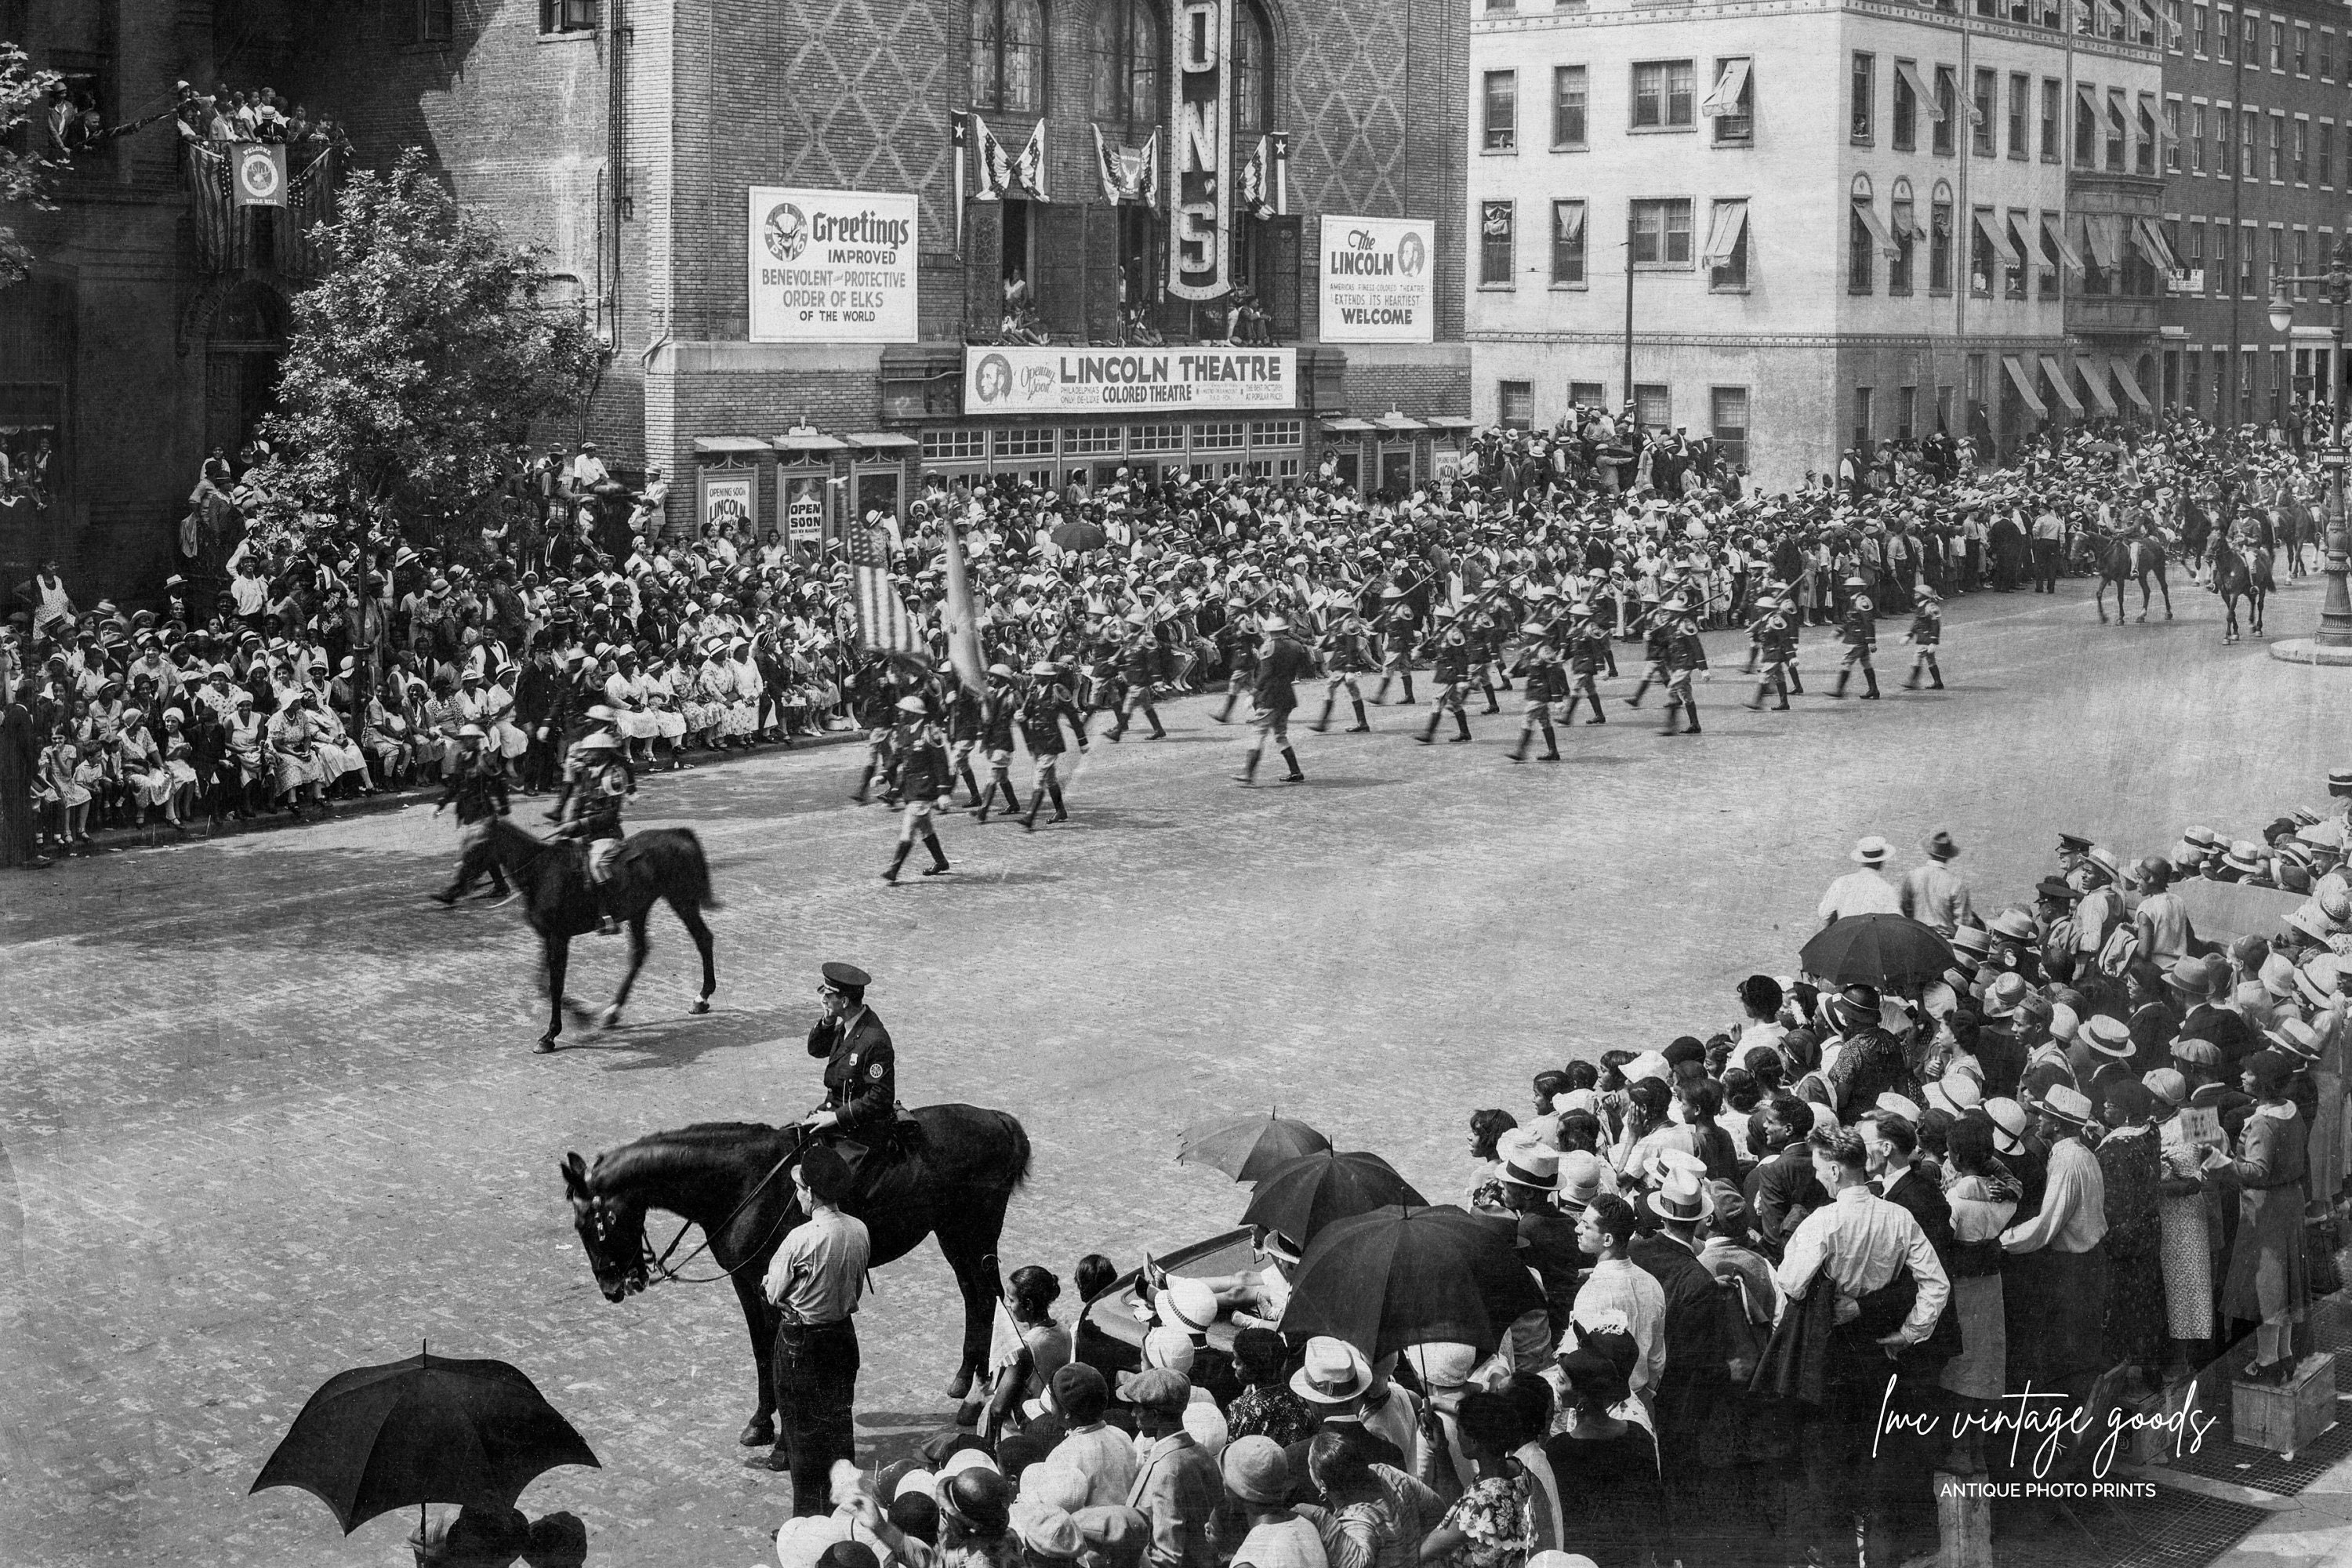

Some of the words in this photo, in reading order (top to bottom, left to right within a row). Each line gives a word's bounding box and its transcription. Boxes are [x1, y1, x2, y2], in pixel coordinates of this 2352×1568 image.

[243, 147, 271, 155] WELCOME
[813, 210, 909, 249] Greetings
[1348, 230, 1375, 250] The
[829, 249, 896, 264] IMPROVED
[1331, 251, 1393, 275] LINCOLN
[762, 268, 833, 286] BENEVOLENT
[844, 271, 906, 288] PROTECTIVE
[783, 290, 824, 307] ORDER
[831, 291, 846, 307] OF
[851, 292, 884, 307] ELKS
[1334, 294, 1365, 305] EXTENDS
[1370, 295, 1381, 306] ITS
[1385, 295, 1420, 306] HEARTIEST
[800, 310, 813, 321] OF
[819, 310, 837, 321] THE
[843, 311, 875, 321] WORLD
[1341, 308, 1413, 325] WELCOME
[1061, 356, 1169, 383] LINCOLN
[1178, 355, 1281, 381] THEATRE
[1021, 365, 1055, 393] Opening
[1102, 386, 1147, 403] COLORED
[1149, 385, 1192, 402] THEATRE
[710, 488, 732, 497] OPENING
[733, 487, 746, 495] SOON
[710, 499, 746, 523] LINCOLN
[790, 504, 820, 514] OPEN
[790, 517, 821, 528] SOON
